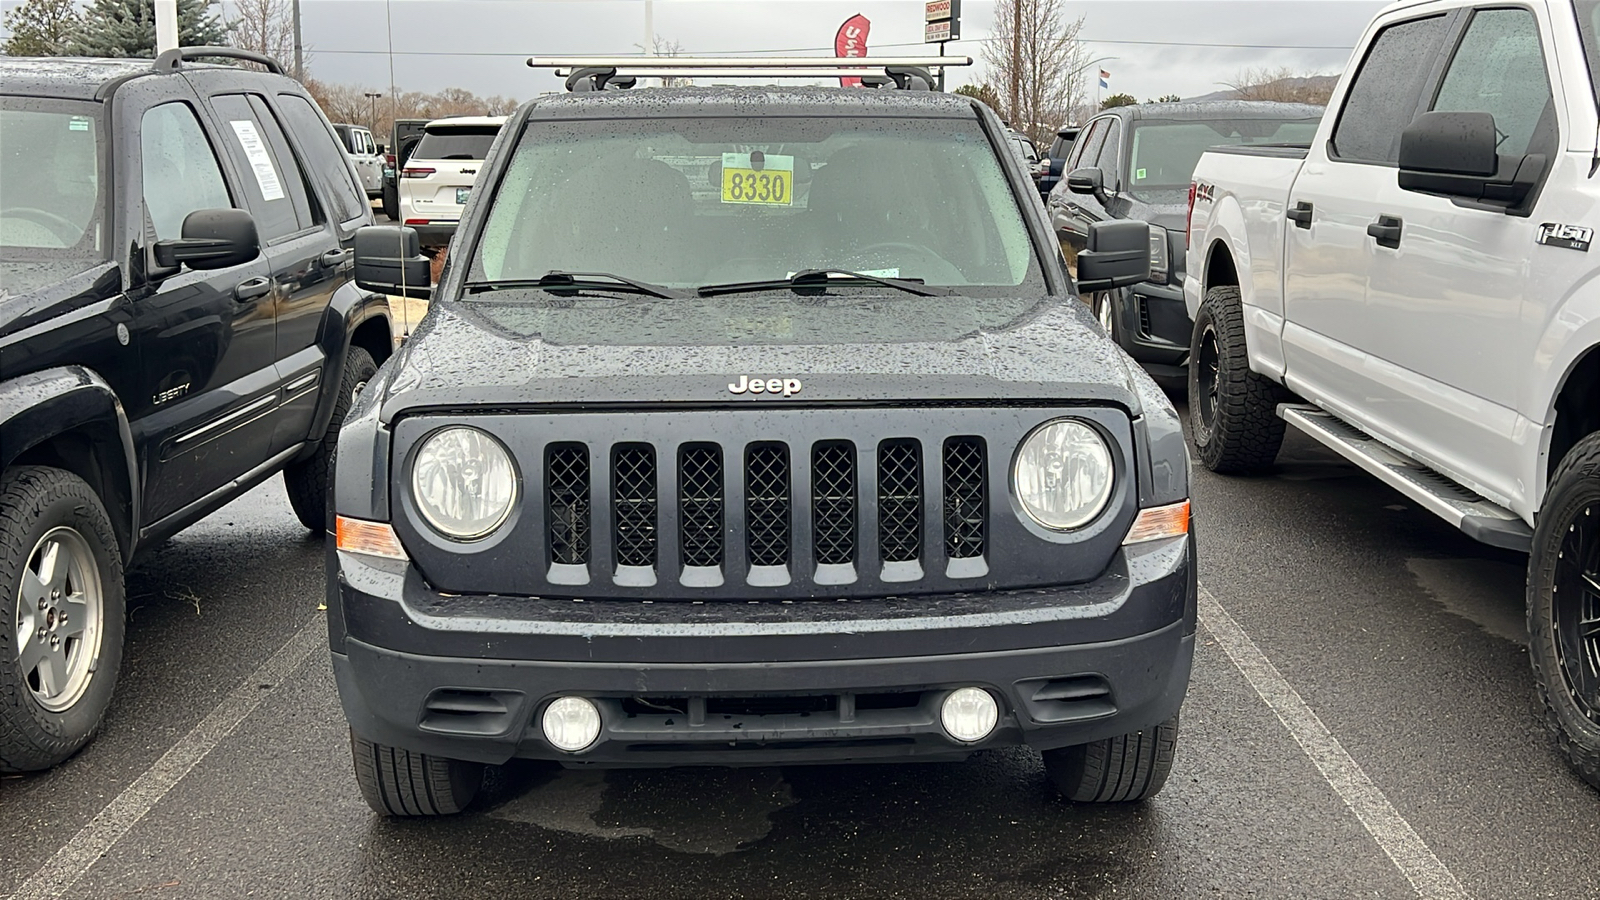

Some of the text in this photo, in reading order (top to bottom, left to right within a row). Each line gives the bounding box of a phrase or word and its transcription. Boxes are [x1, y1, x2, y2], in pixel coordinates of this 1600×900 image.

[927, 1, 950, 12] REDWOOD
[730, 172, 785, 202] 8330
[1570, 241, 1583, 249] XLT
[152, 382, 191, 405] LIBERTY
[727, 375, 802, 398] Jeep
